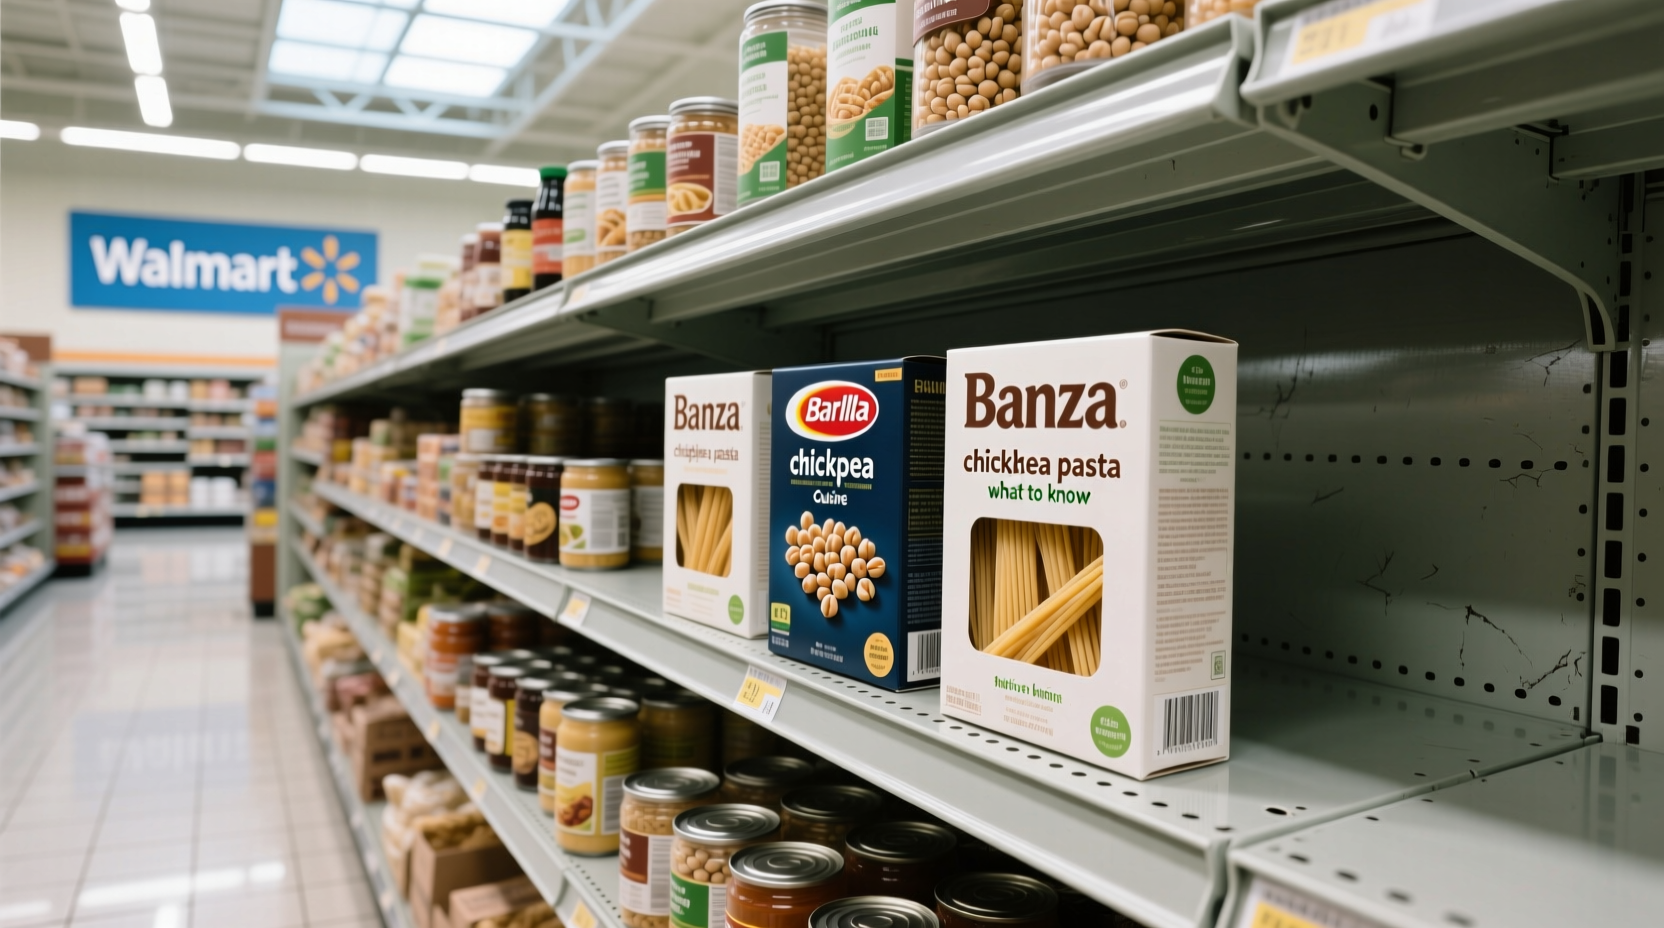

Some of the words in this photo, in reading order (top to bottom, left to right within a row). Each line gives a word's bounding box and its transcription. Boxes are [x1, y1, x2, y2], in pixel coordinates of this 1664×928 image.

[89, 234, 298, 293] Walmart
[673, 394, 740, 431] Banza
[964, 372, 1119, 429] Banza
[789, 448, 874, 488] chickpea
[1057, 453, 1121, 484] pasta
[987, 480, 1023, 501] what
[1027, 484, 1043, 502] to
[1048, 483, 1092, 505] know
